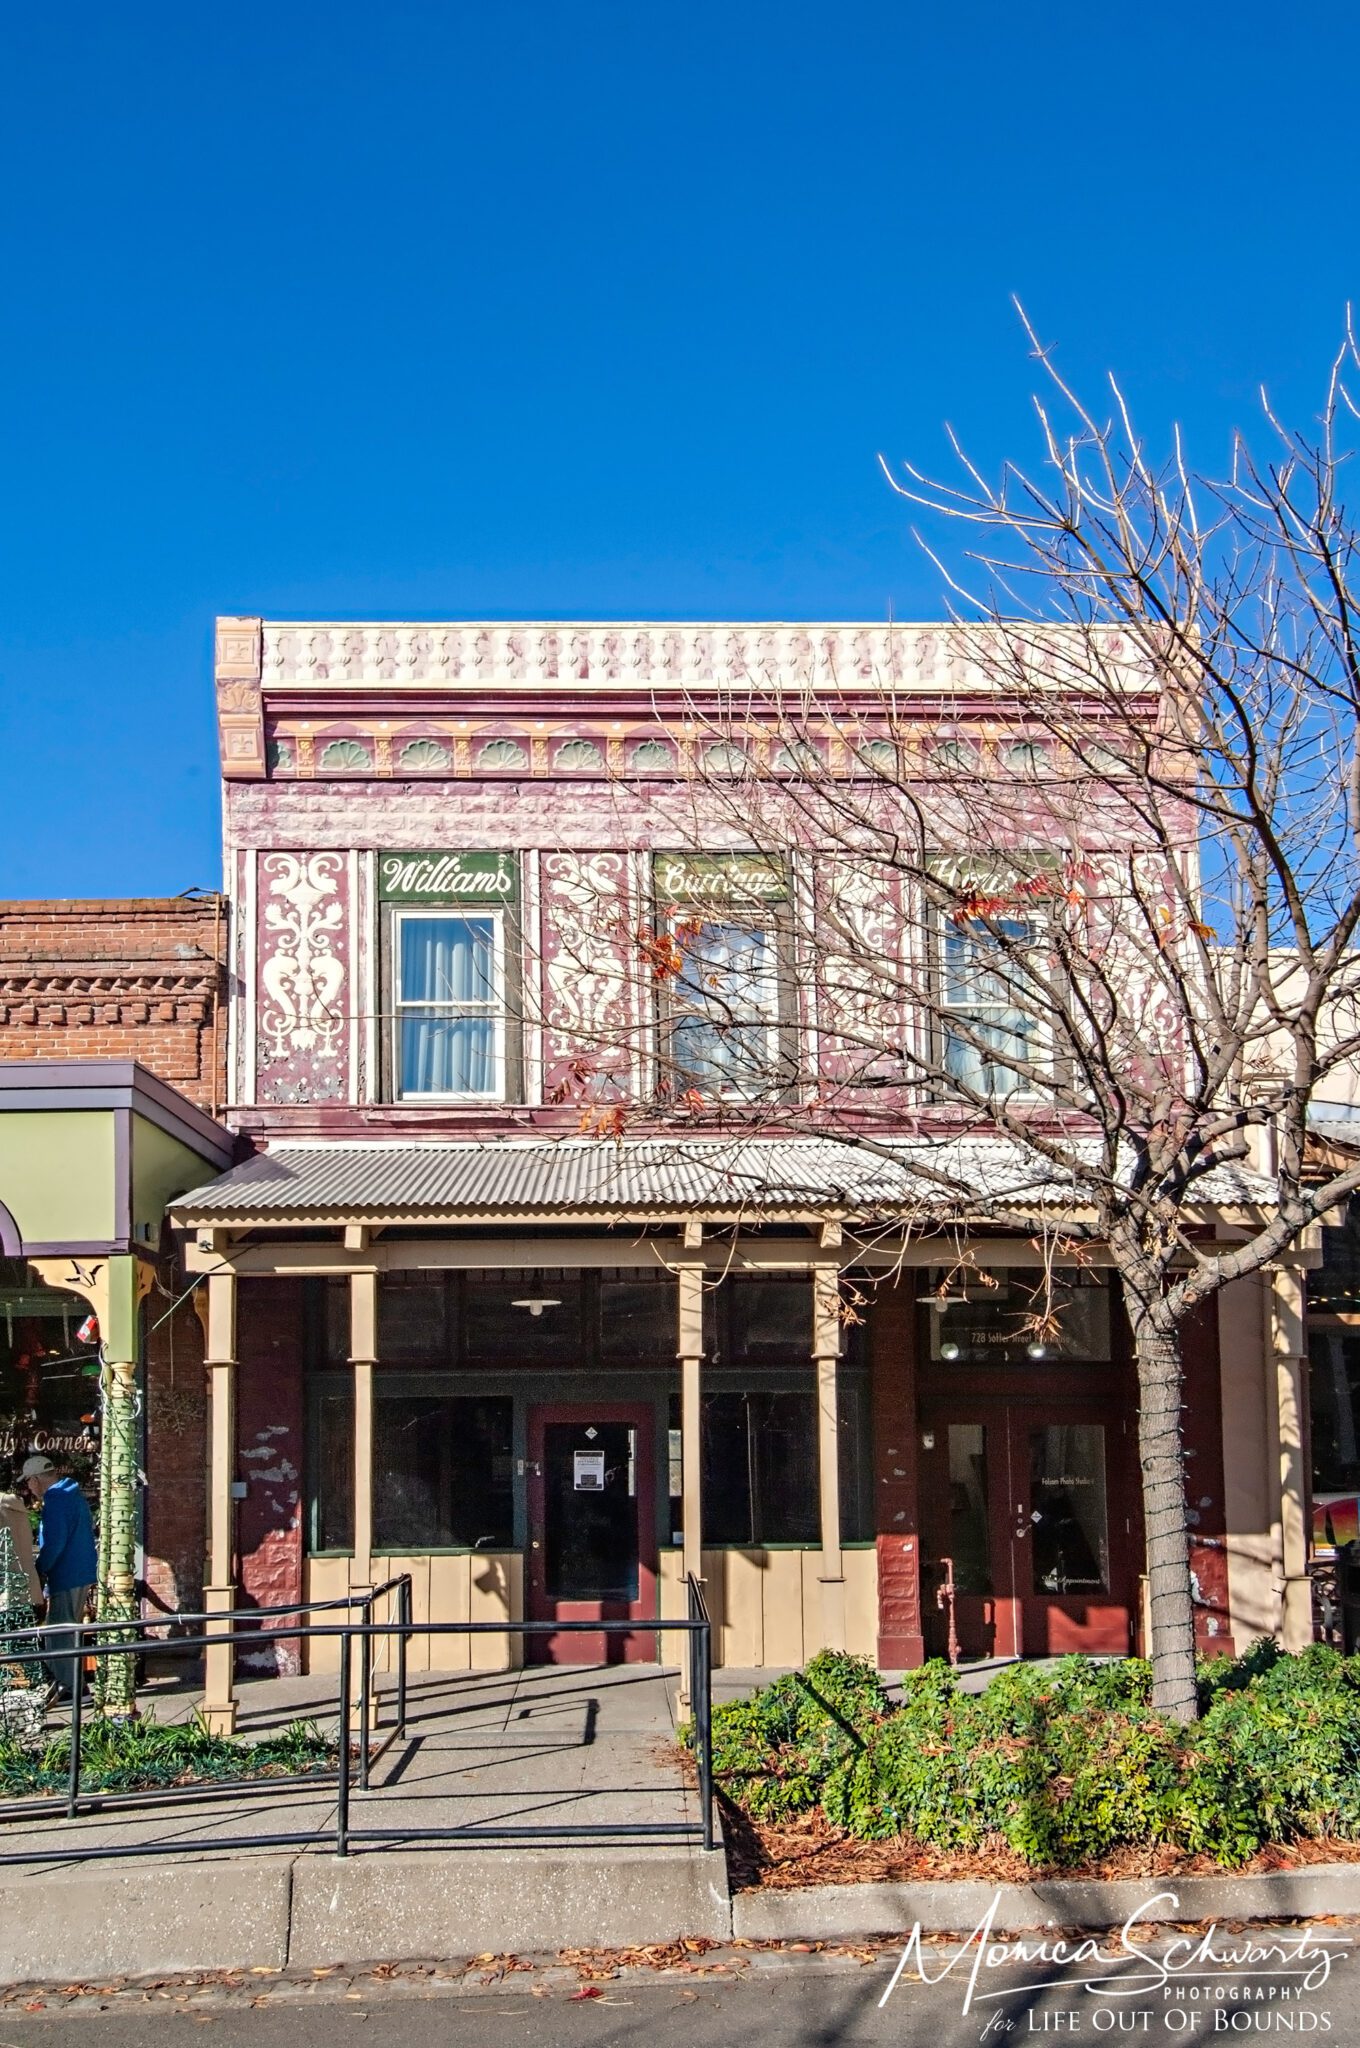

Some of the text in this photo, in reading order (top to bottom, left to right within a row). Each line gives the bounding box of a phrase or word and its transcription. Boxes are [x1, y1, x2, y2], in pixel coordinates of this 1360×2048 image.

[383, 854, 512, 893] Williams
[971, 1332, 985, 1343] 728
[34, 1430, 90, 1451] Corner
